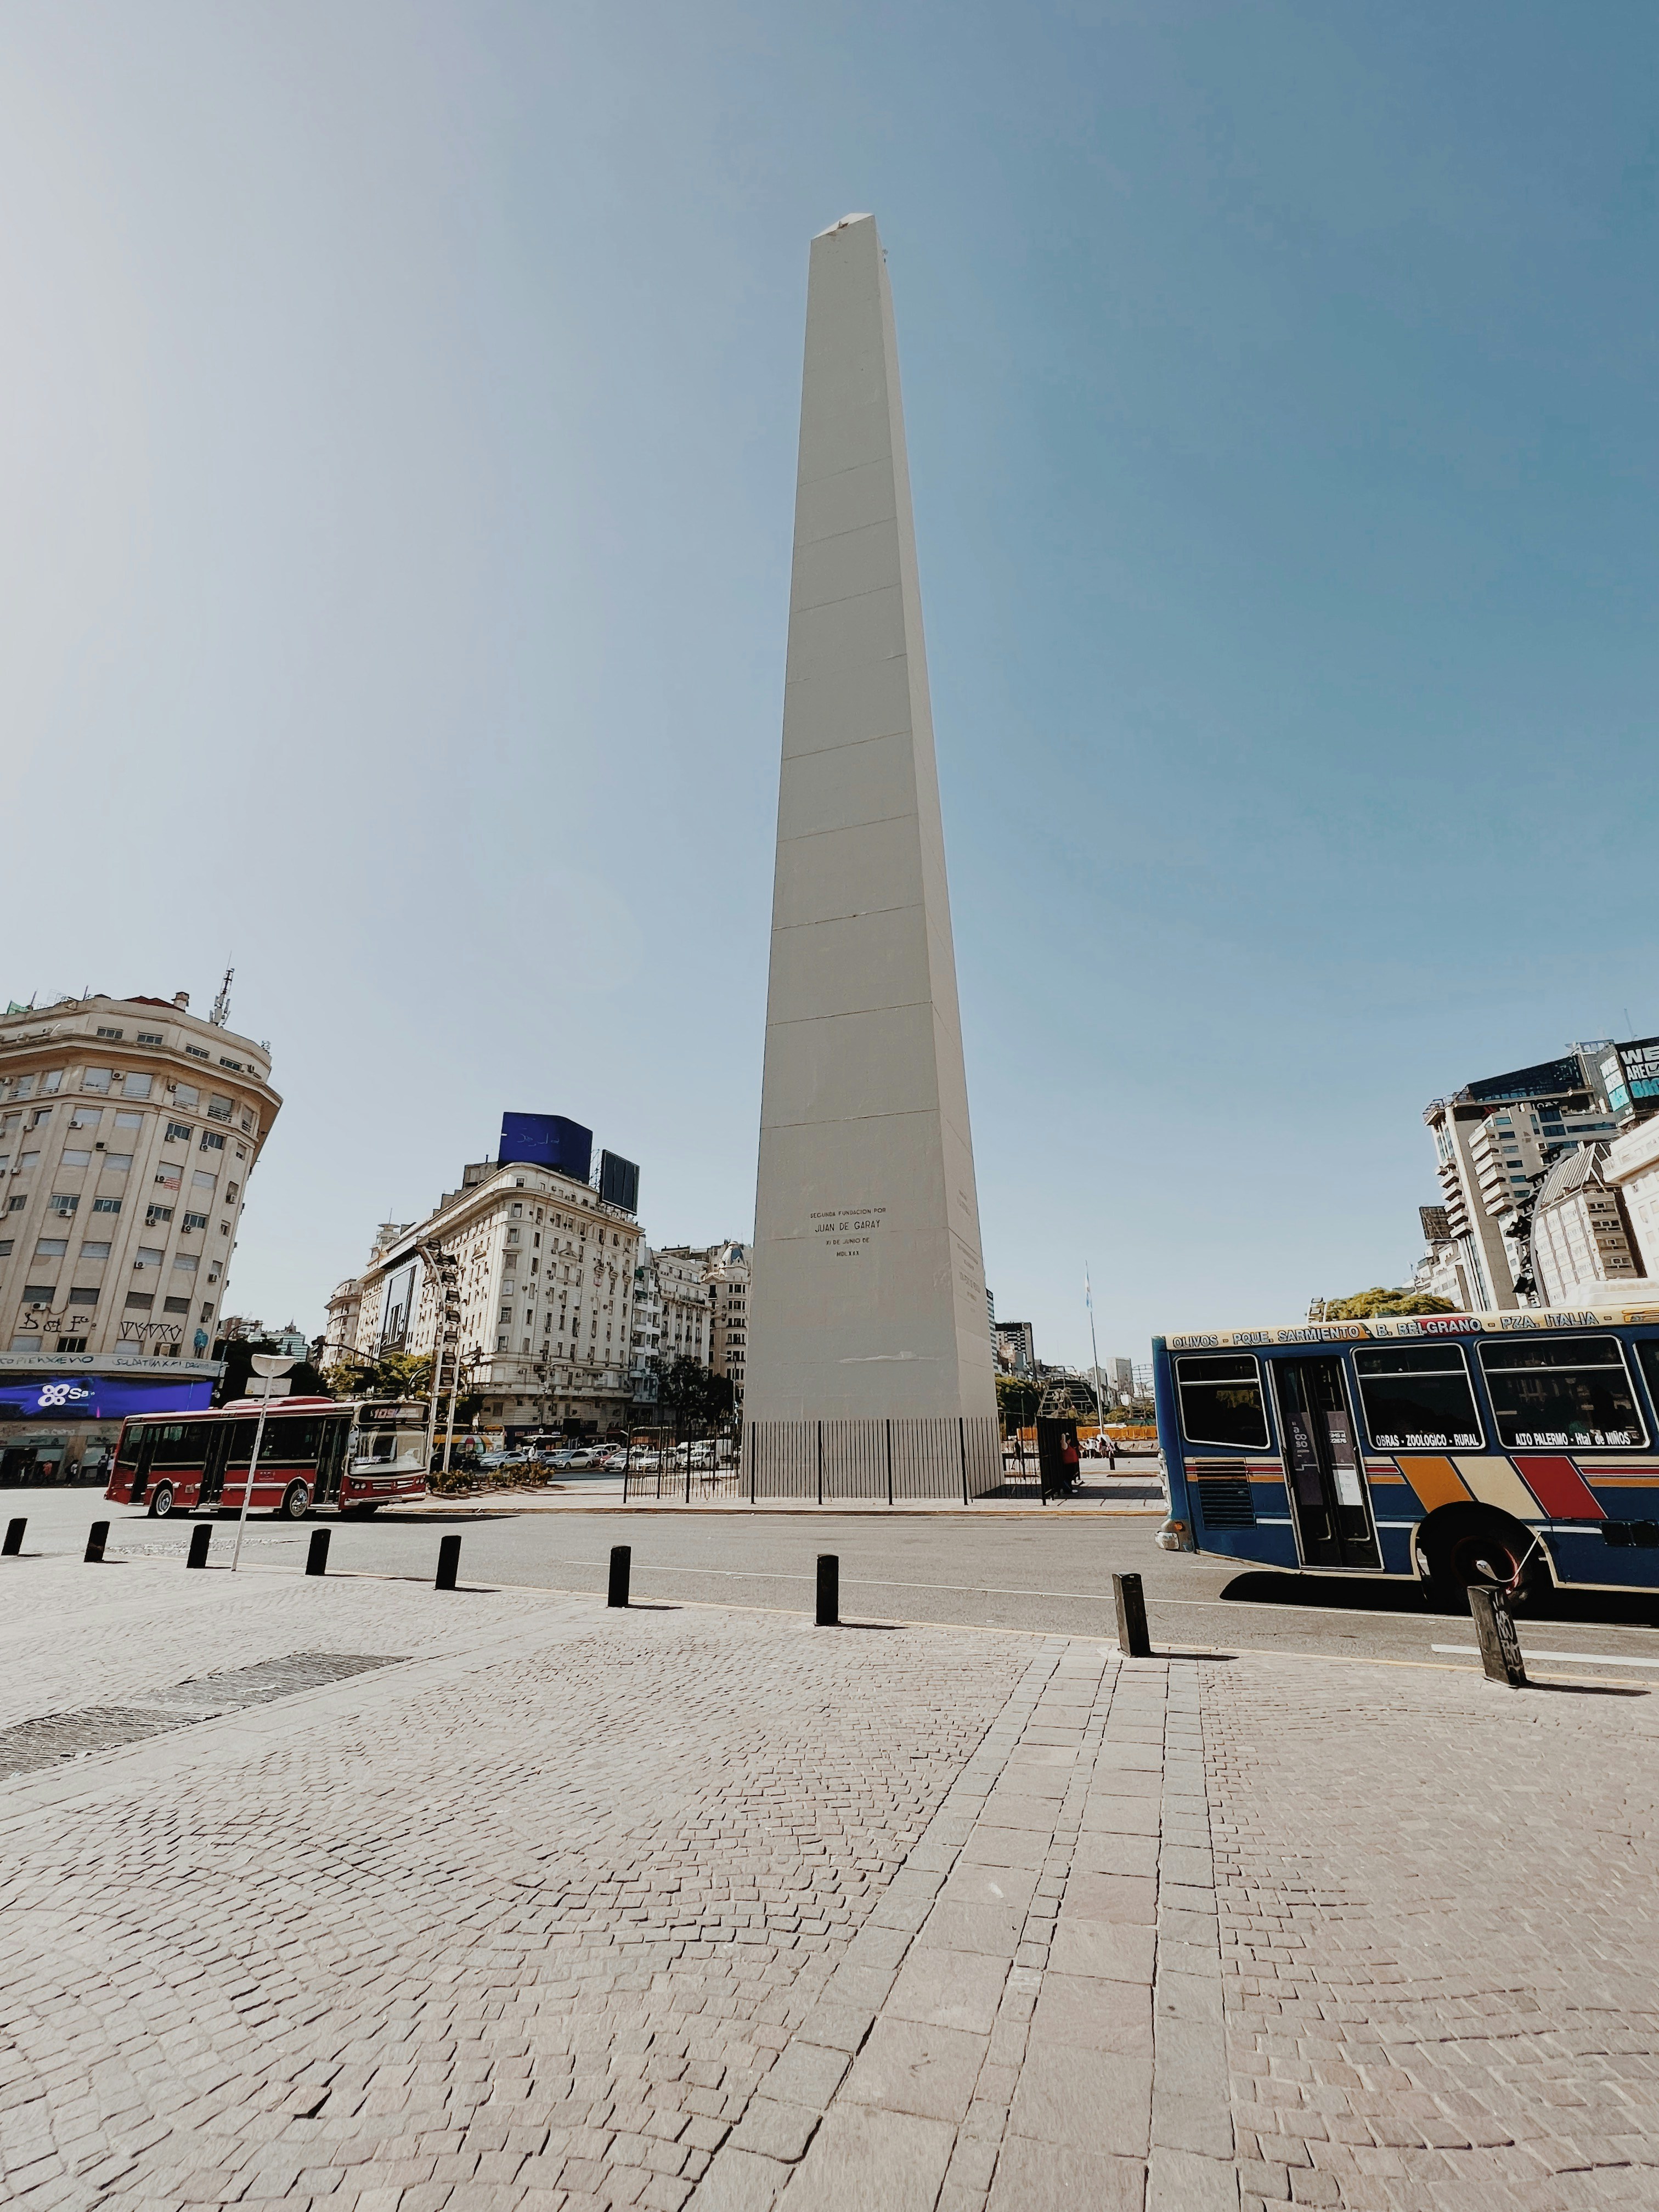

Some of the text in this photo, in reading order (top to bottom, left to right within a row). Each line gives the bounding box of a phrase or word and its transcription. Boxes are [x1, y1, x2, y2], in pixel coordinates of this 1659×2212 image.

[1620, 1046, 1659, 1064] WE
[1626, 1064, 1648, 1080] ARE
[815, 1220, 880, 1232] JUAN DE GARAY
[1172, 1334, 1218, 1349] OLIVOS
[1232, 1331, 1273, 1345] PQUE.
[1278, 1325, 1359, 1342] SARMIENTO
[1376, 1324, 1392, 1336] B.
[1397, 1318, 1482, 1335] BELGRANO
[1500, 1316, 1540, 1329] PZA.
[1544, 1312, 1599, 1327] ITALIA
[1376, 1434, 1400, 1446] OBRAS
[1406, 1434, 1447, 1446] ZOOLOGICO
[1454, 1434, 1480, 1446] RURAL
[1515, 1432, 1532, 1446] ALTO
[1533, 1432, 1568, 1446] PALERMO
[1575, 1432, 1592, 1446] Htal
[1595, 1433, 1605, 1445] de
[1605, 1430, 1631, 1445] NIÑOS
